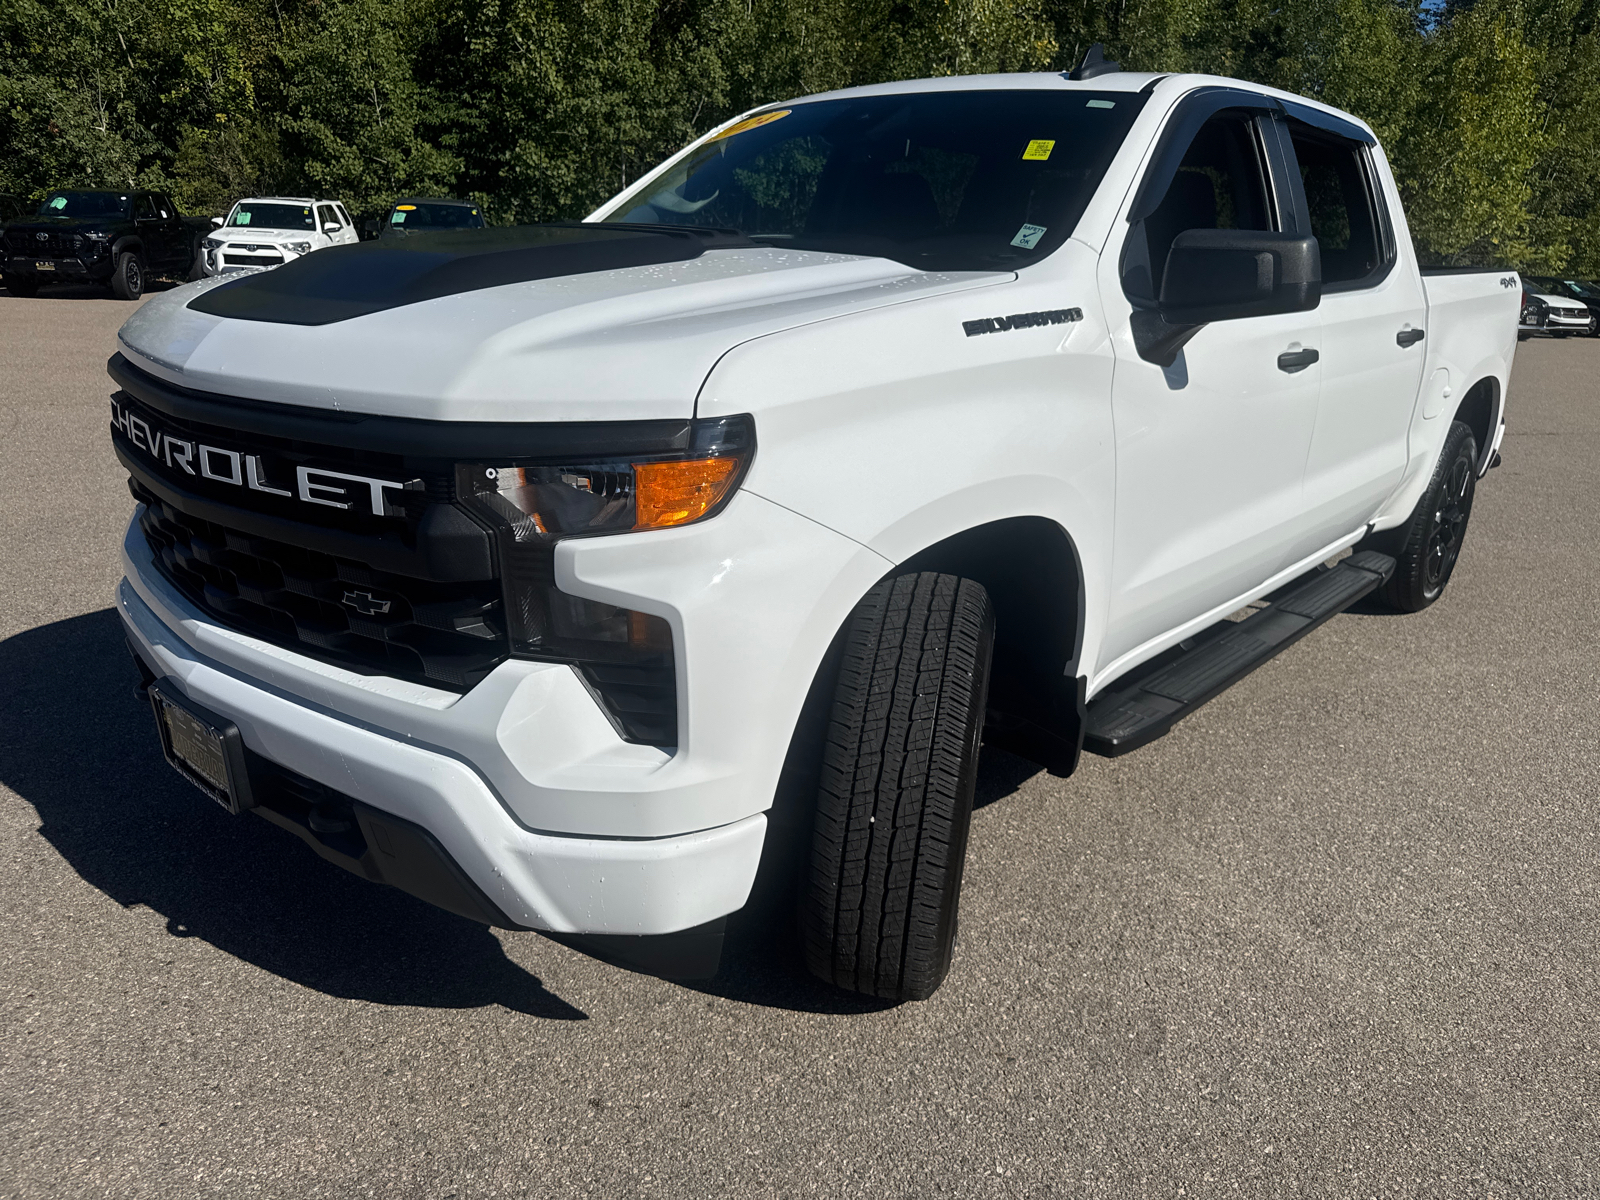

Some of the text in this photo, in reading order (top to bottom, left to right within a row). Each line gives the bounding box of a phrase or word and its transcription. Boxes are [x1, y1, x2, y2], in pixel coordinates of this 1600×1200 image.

[1023, 225, 1045, 233] SAFETY
[962, 306, 1084, 337] SILVERADO
[110, 397, 404, 516] CHEVROLET
